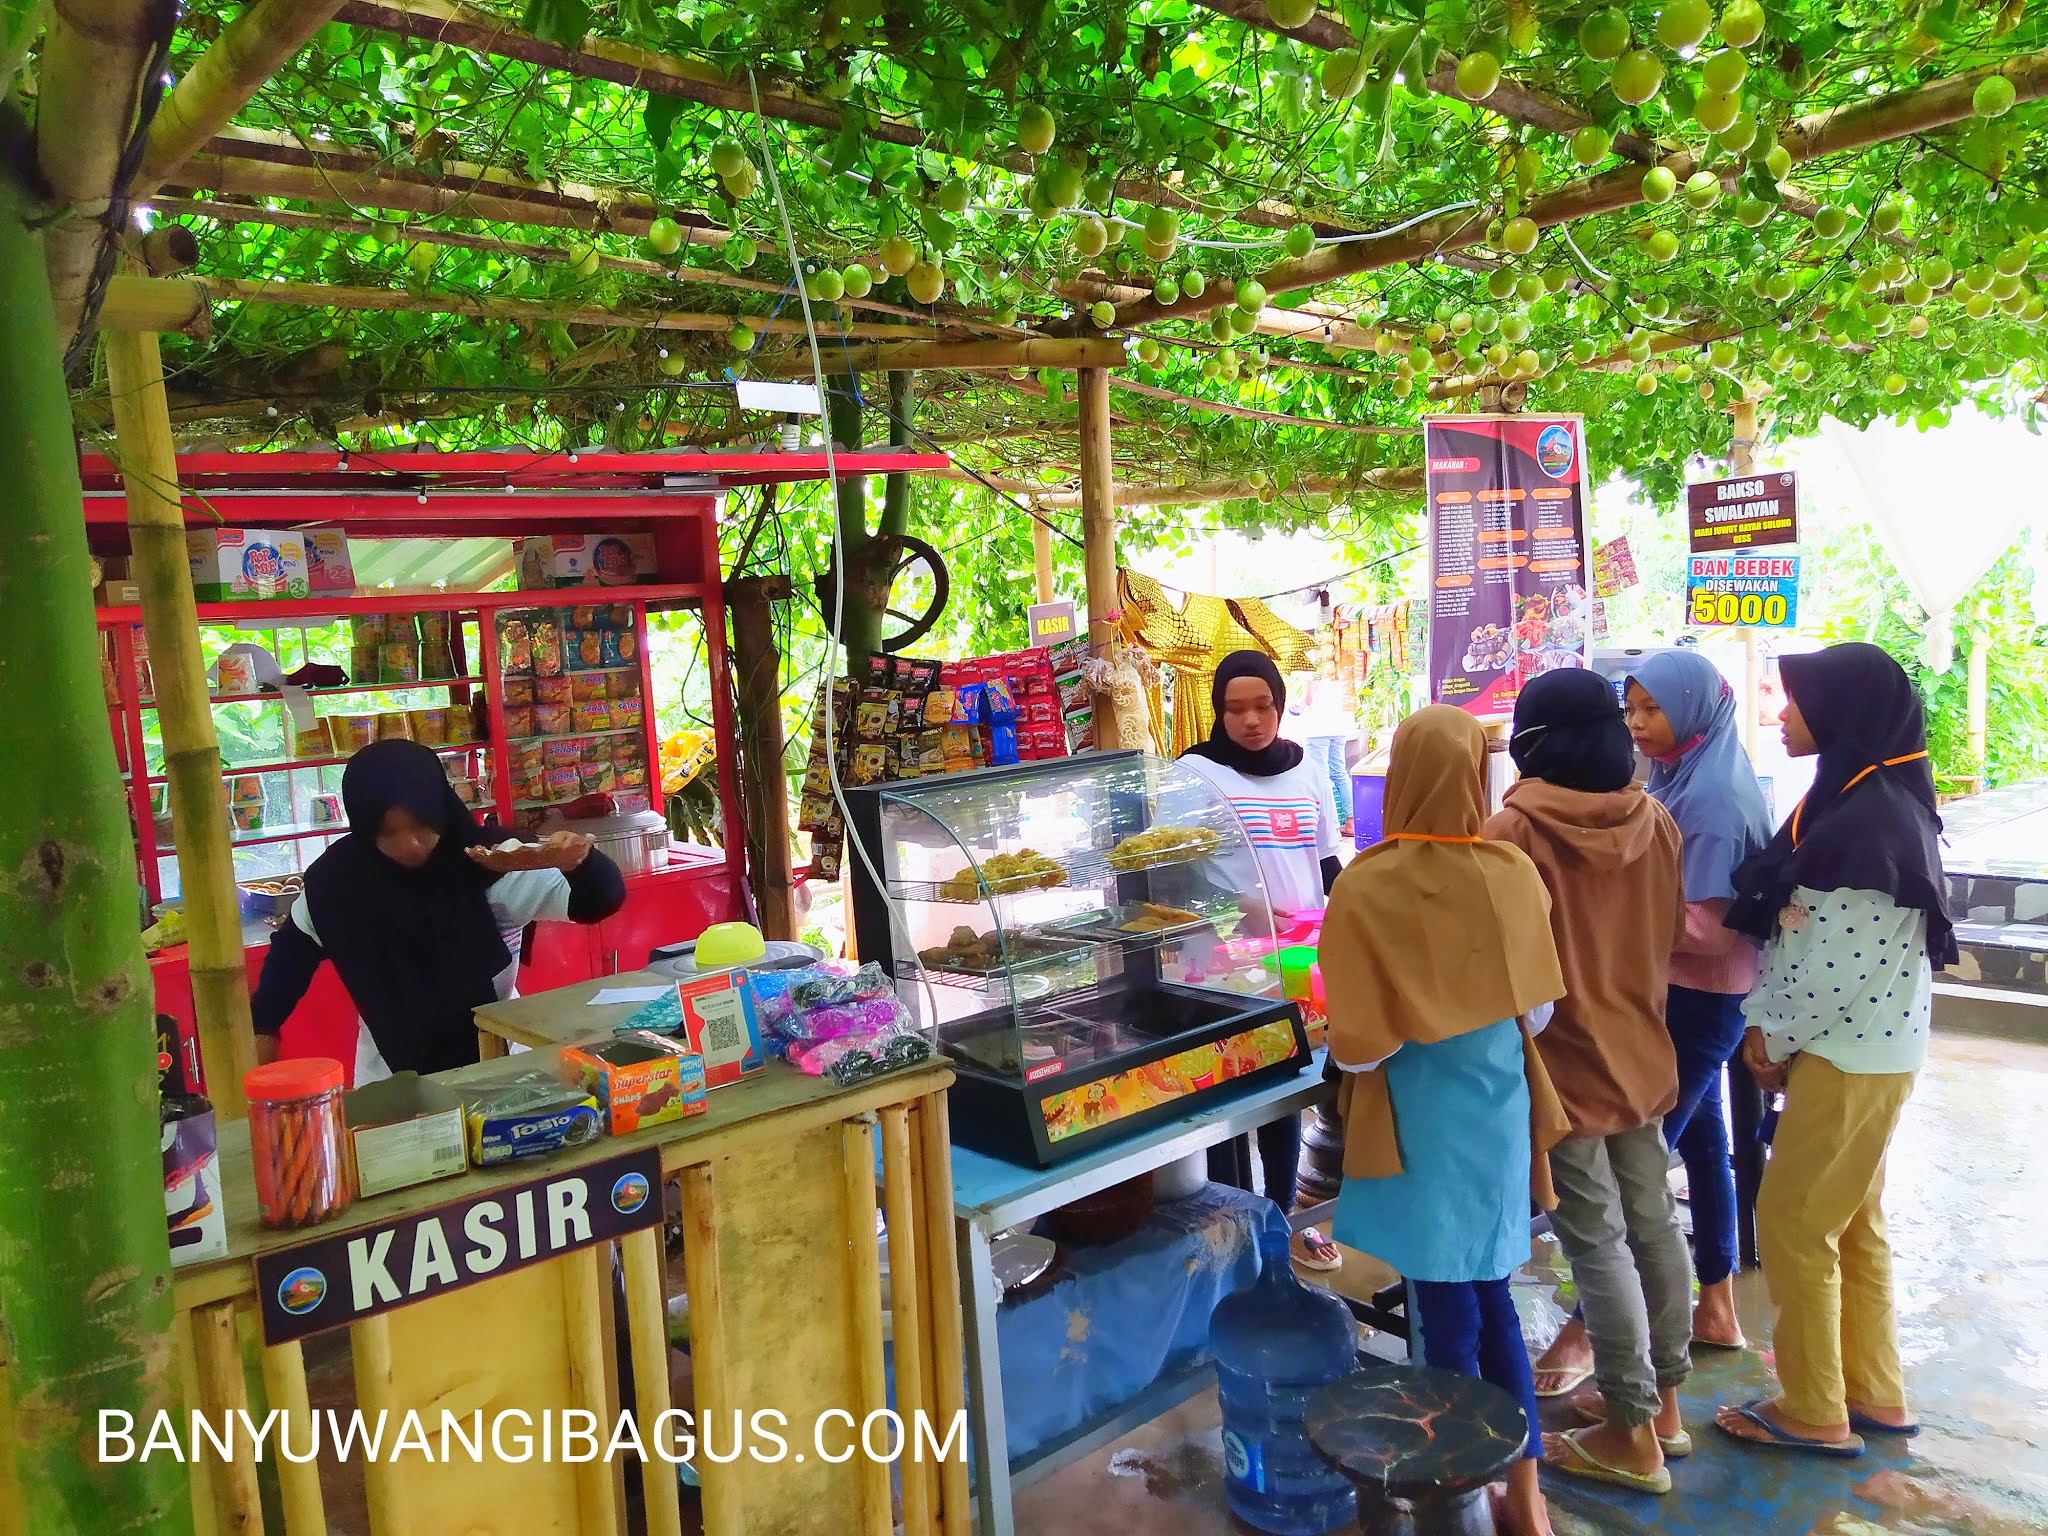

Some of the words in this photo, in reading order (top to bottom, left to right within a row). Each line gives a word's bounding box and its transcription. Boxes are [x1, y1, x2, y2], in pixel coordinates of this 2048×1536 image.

[1717, 480, 1764, 500] BAKSO
[1704, 500, 1779, 523] SWALAYAN
[1733, 534, 1752, 544] GESS
[249, 548, 270, 564] POP
[253, 559, 278, 575] MIE
[1692, 559, 1729, 577] BAN
[1734, 559, 1795, 577] BEBEK
[1705, 579, 1779, 592] DISEWAKAN
[1694, 594, 1787, 624] 5000
[1037, 616, 1070, 635] KASIR
[347, 1177, 593, 1311] KASIR
